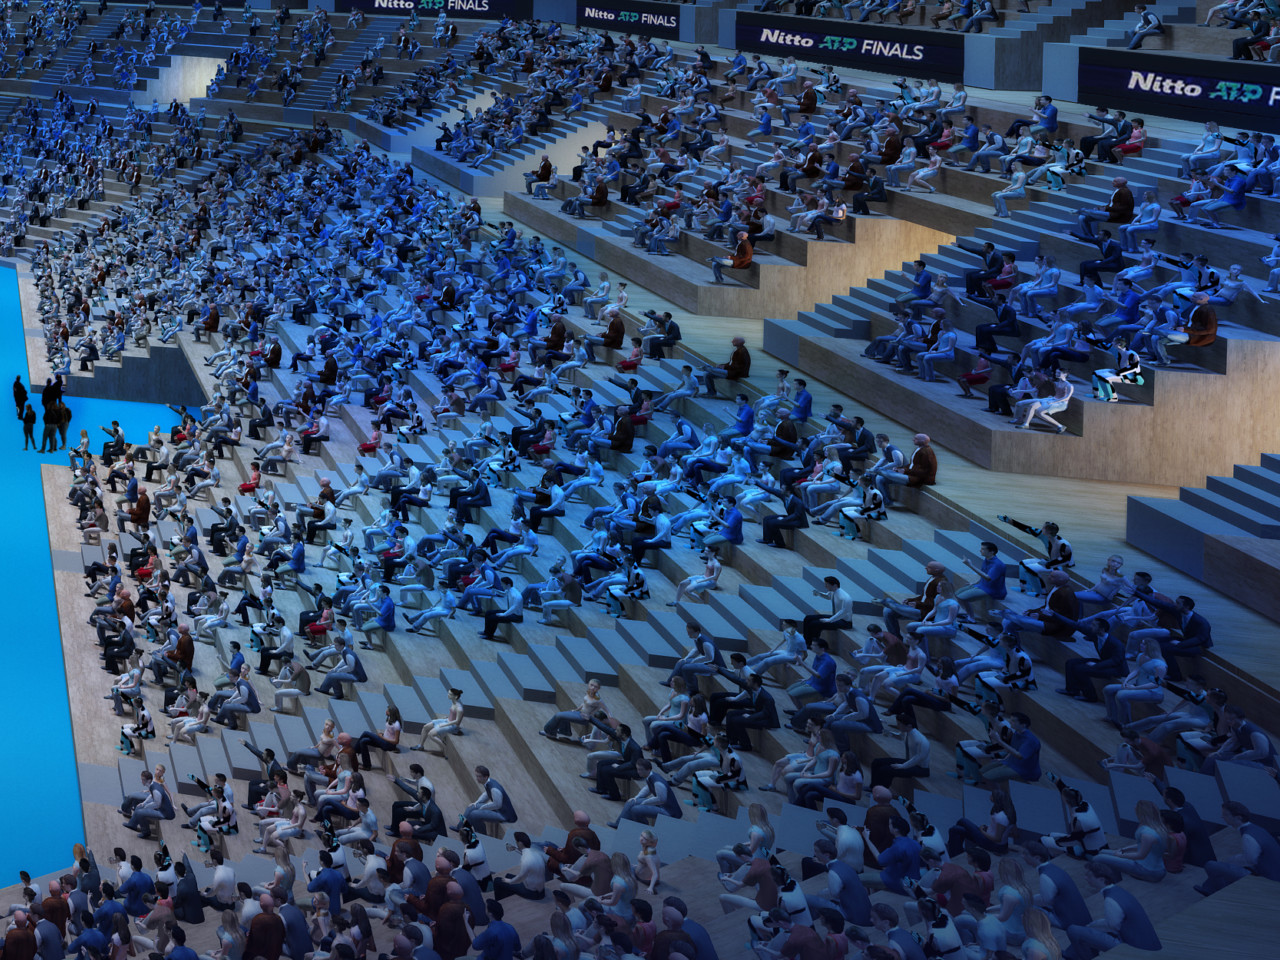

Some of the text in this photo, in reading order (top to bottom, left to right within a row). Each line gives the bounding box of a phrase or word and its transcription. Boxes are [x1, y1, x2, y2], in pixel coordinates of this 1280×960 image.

[447, 0, 489, 11] FINALS
[585, 7, 677, 27] Nitto ATP FINALS
[760, 28, 924, 60] Nitto ATP FINALS
[1128, 70, 1202, 96] Nitto
[1209, 81, 1263, 103] ATP
